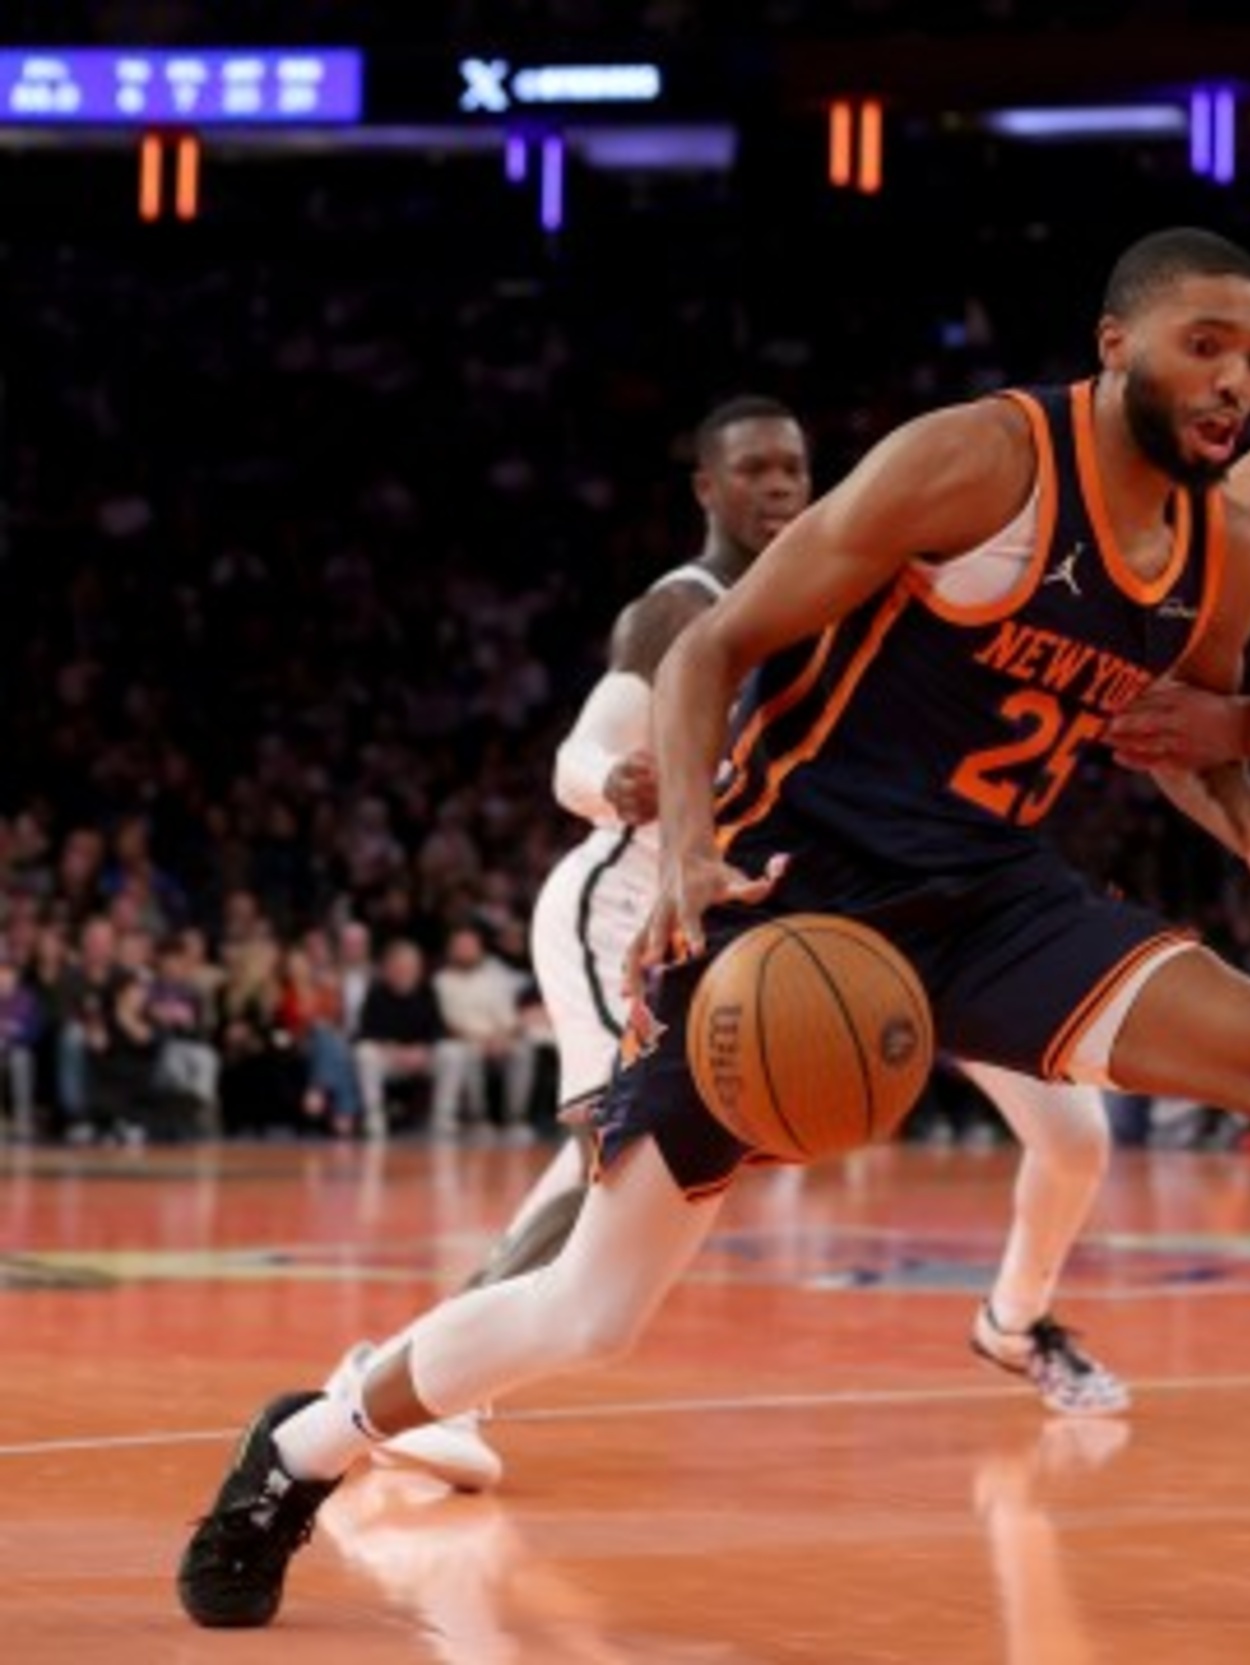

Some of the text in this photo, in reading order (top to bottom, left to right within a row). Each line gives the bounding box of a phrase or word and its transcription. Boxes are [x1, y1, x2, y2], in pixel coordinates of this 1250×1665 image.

[974, 621, 1153, 712] NEW YO
[950, 689, 1105, 825] 25
